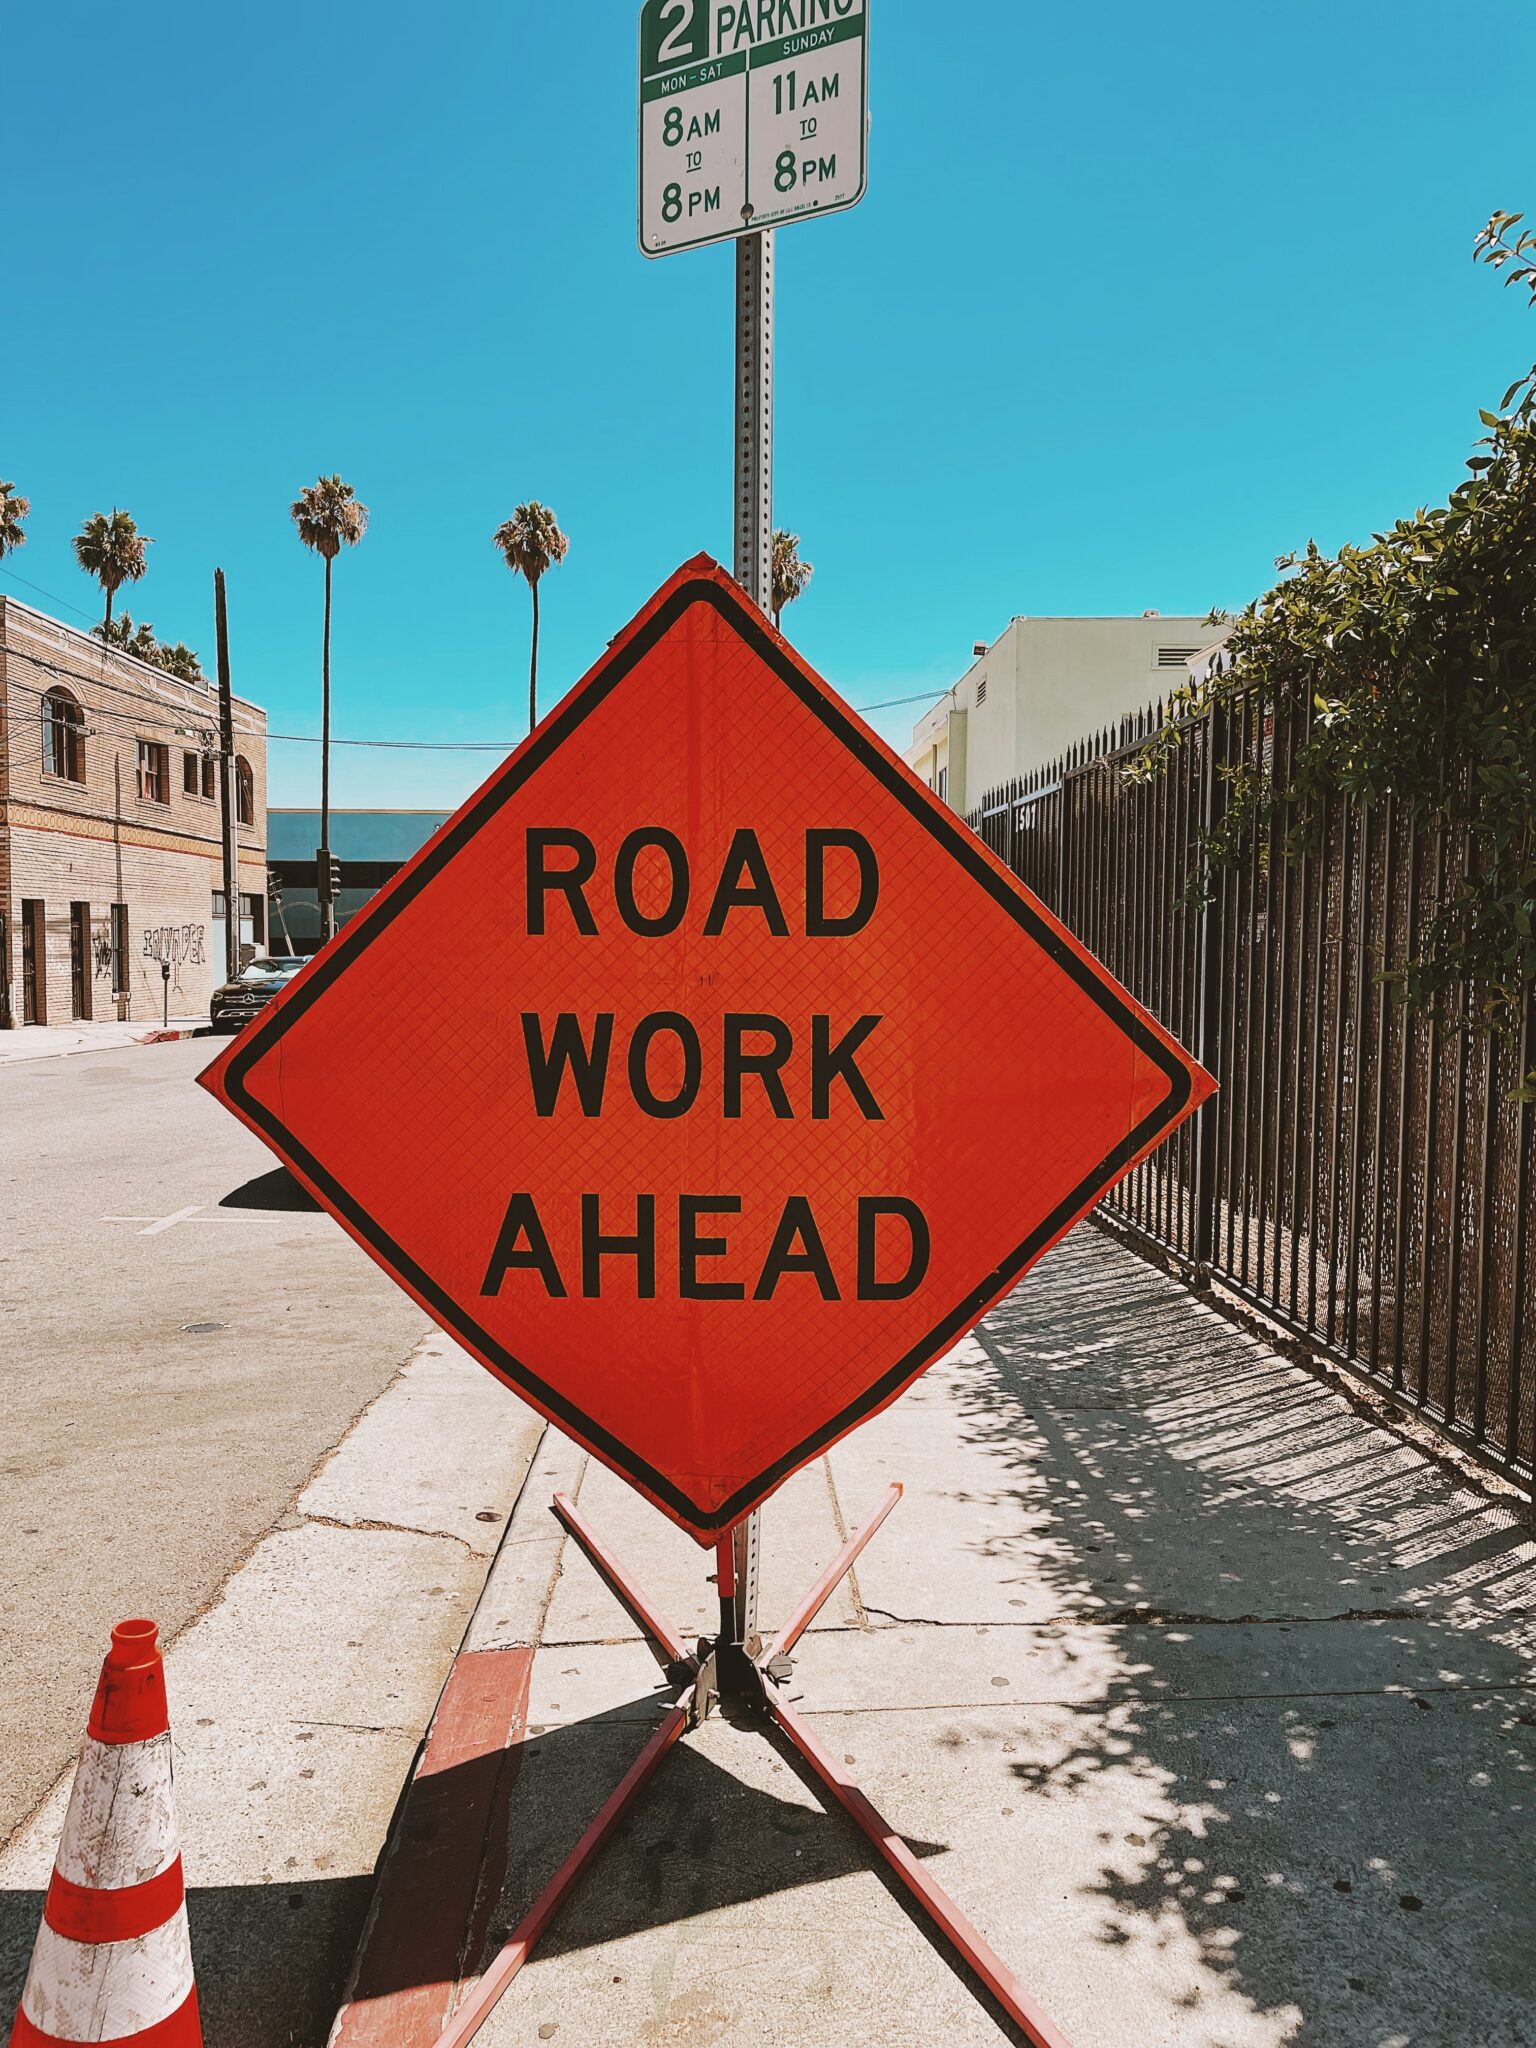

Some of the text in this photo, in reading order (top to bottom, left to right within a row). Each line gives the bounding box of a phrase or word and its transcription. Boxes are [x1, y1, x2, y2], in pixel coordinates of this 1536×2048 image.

[657, 0, 695, 63] 2
[783, 26, 835, 55] SUNDAY
[800, 117, 817, 137] TO
[686, 150, 702, 170] TO
[526, 827, 879, 937] ROAD
[521, 1011, 885, 1120] WORK
[480, 1193, 930, 1300] AHEAD
